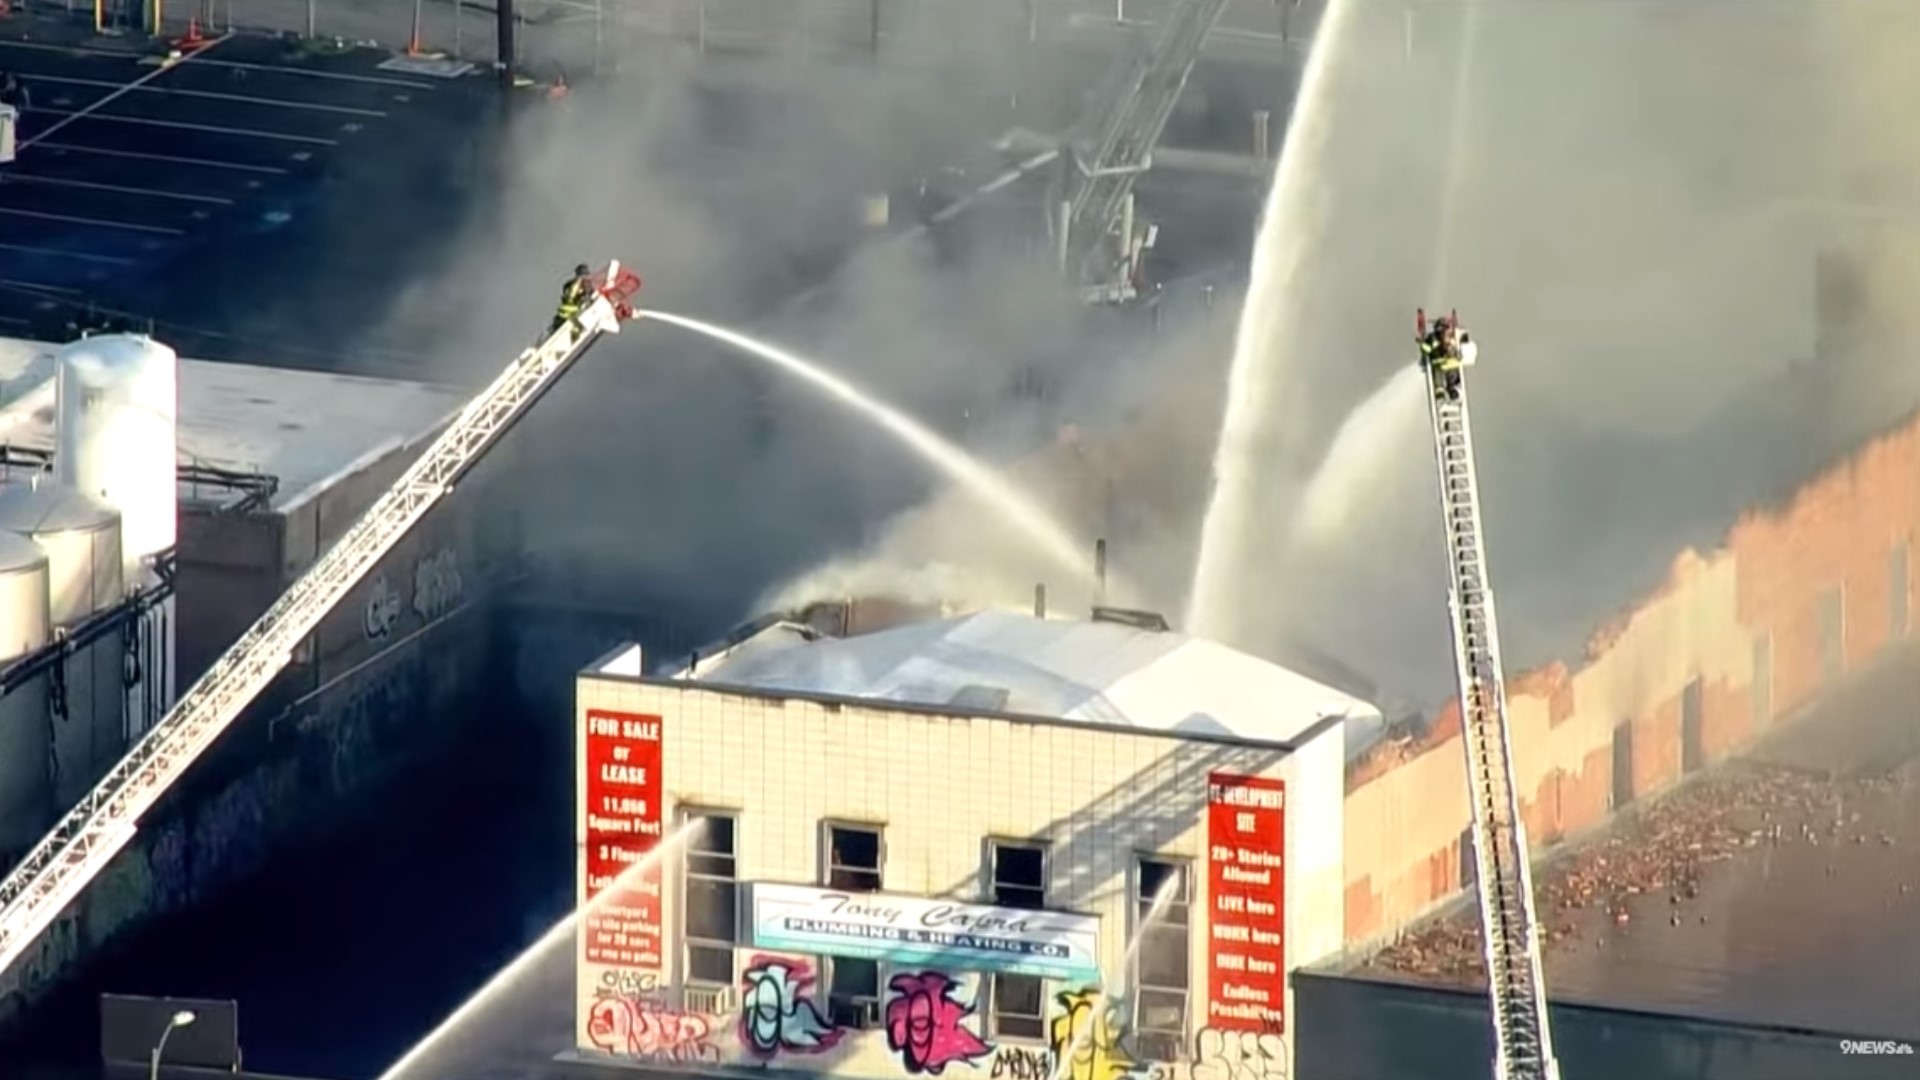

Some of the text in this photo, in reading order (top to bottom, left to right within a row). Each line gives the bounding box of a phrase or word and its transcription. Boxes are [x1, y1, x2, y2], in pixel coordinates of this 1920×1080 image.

[590, 717, 659, 741] FOR SALE
[601, 763, 646, 785] LEASE
[589, 813, 660, 835] Square Feet
[1236, 812, 1256, 833] SITE
[1238, 847, 1281, 868] Stories
[1223, 866, 1270, 885] Allowed
[819, 894, 902, 923] Tony
[1217, 895, 1275, 915] LIVE here
[788, 919, 899, 940] PLUMBING
[905, 930, 922, 943] &
[929, 931, 1022, 952] HEATING
[1213, 924, 1280, 945] WORK here
[1248, 956, 1276, 974] here
[1223, 983, 1269, 1002] Endless
